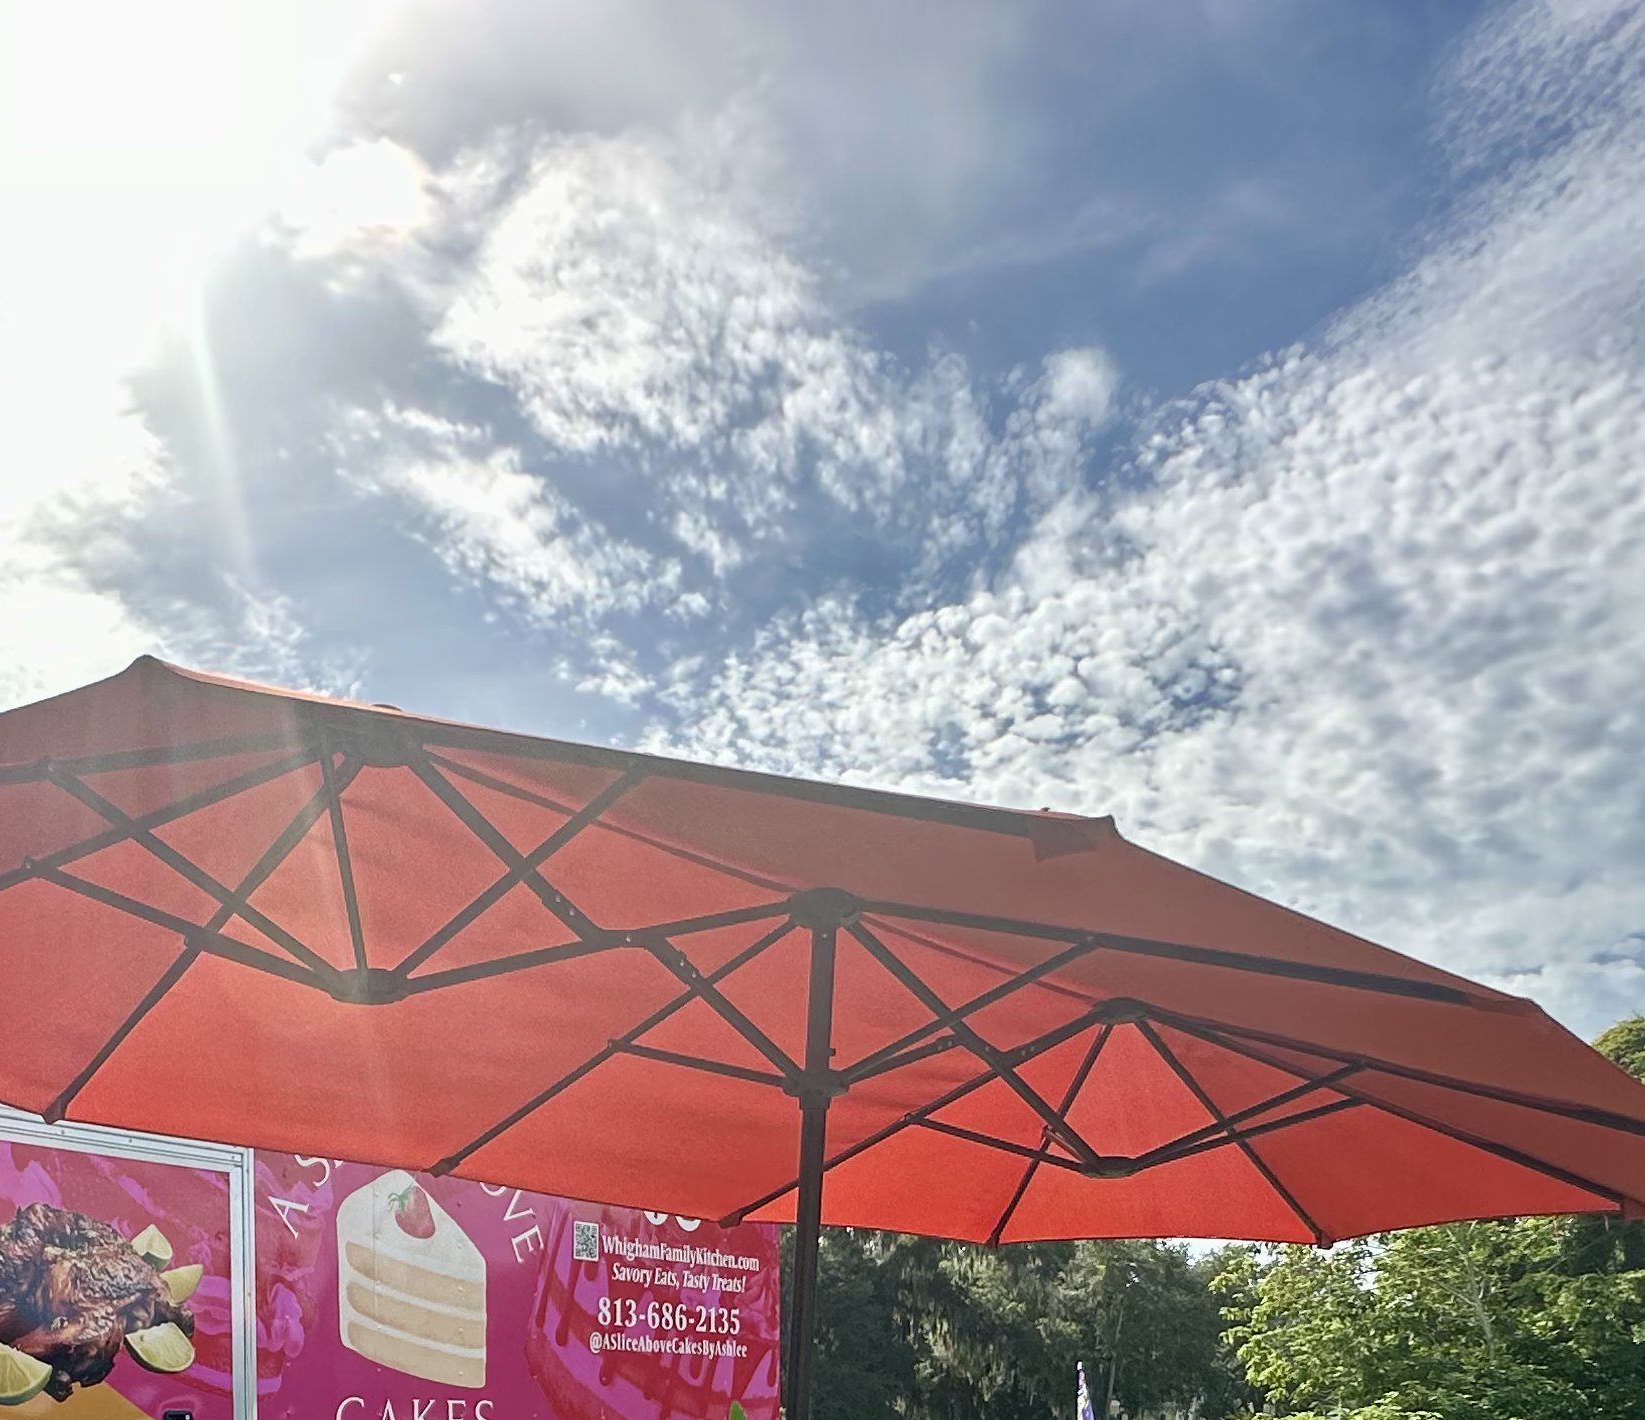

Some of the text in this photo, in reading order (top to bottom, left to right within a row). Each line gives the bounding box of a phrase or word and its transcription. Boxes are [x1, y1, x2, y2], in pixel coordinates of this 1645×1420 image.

[602, 1235, 759, 1271] WhighamFamilyKitchen.com
[611, 1262, 747, 1294] Savory Eats, Tasty Treats!
[598, 1297, 740, 1334] 813-686-2135
[590, 1332, 747, 1359] @ASliceAboveCakesByAshlee
